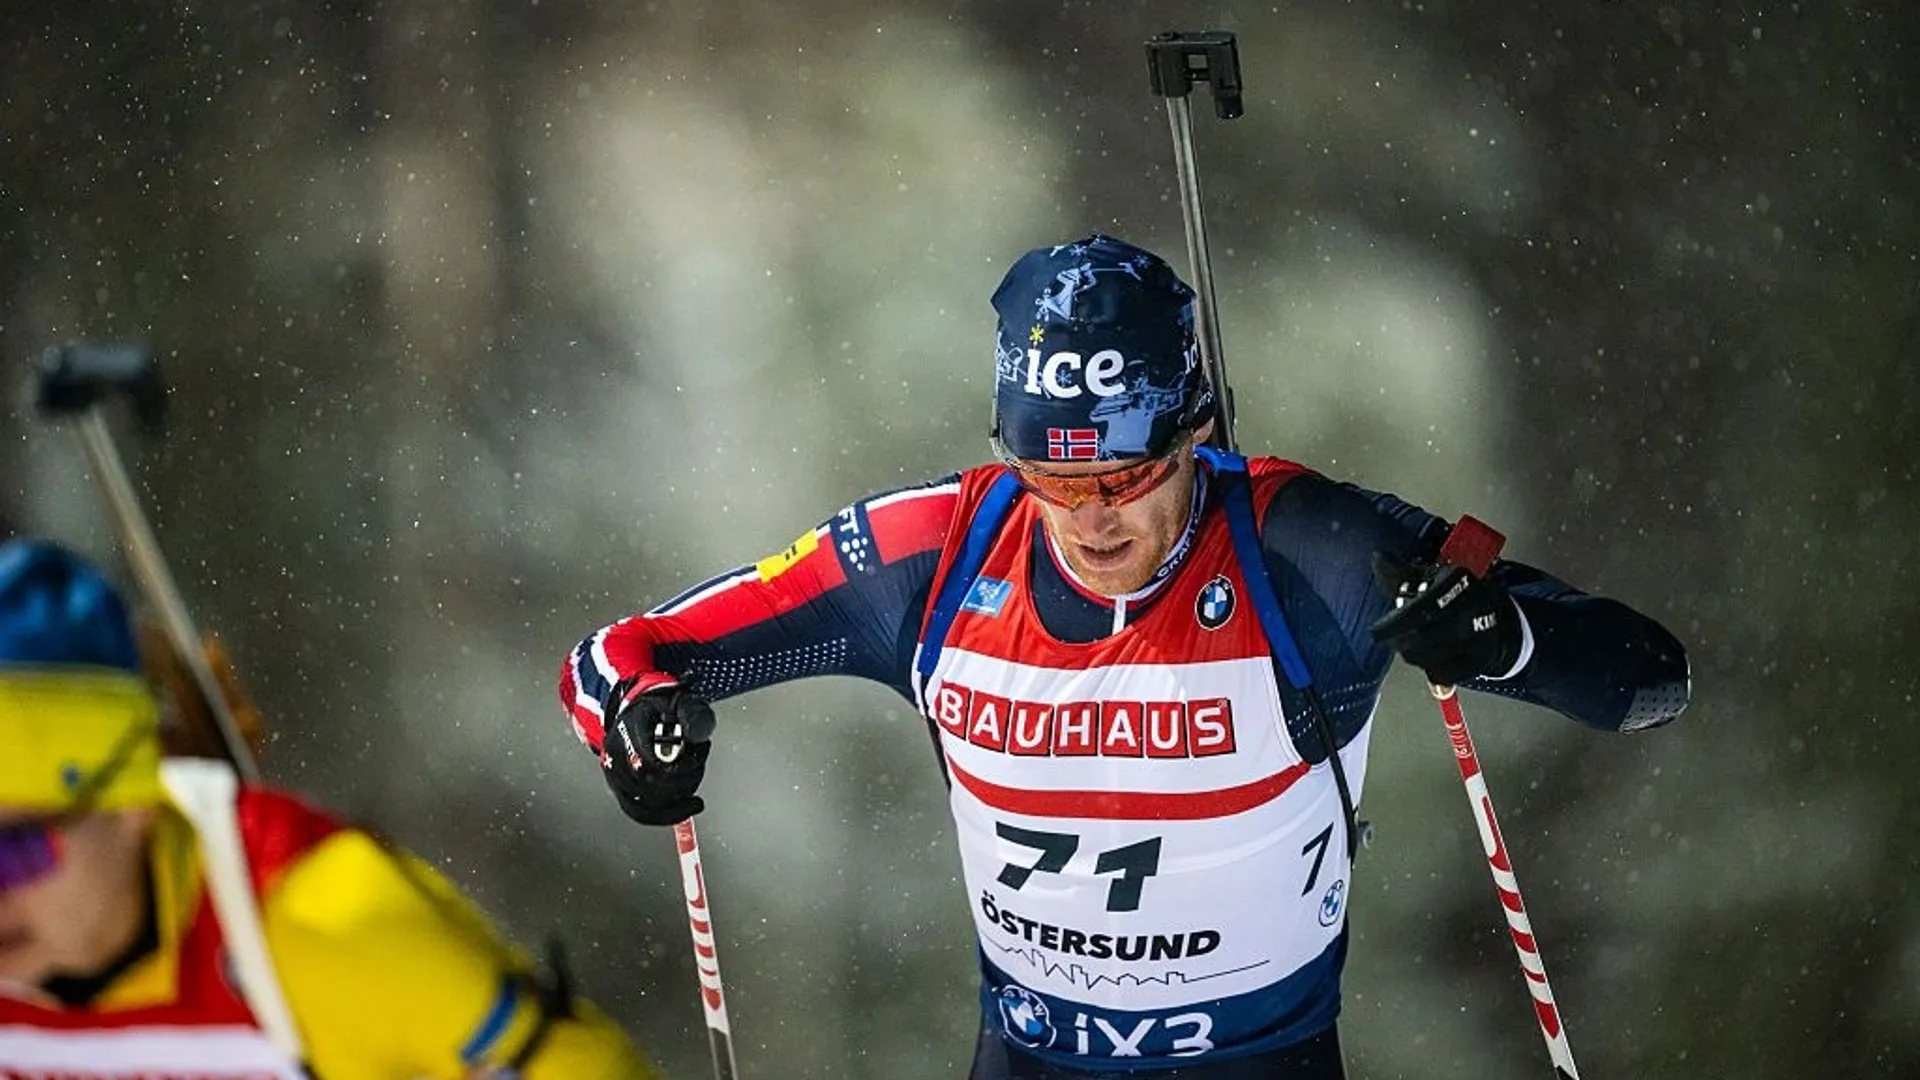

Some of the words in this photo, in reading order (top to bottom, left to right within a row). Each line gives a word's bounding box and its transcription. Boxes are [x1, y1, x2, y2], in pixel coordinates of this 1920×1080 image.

[1024, 346, 1127, 399] ice
[940, 687, 1226, 750] BAUHAUS
[995, 821, 1162, 913] 71
[980, 889, 1222, 962] ÖSTERSUND
[1074, 1012, 1215, 1057] iX3
